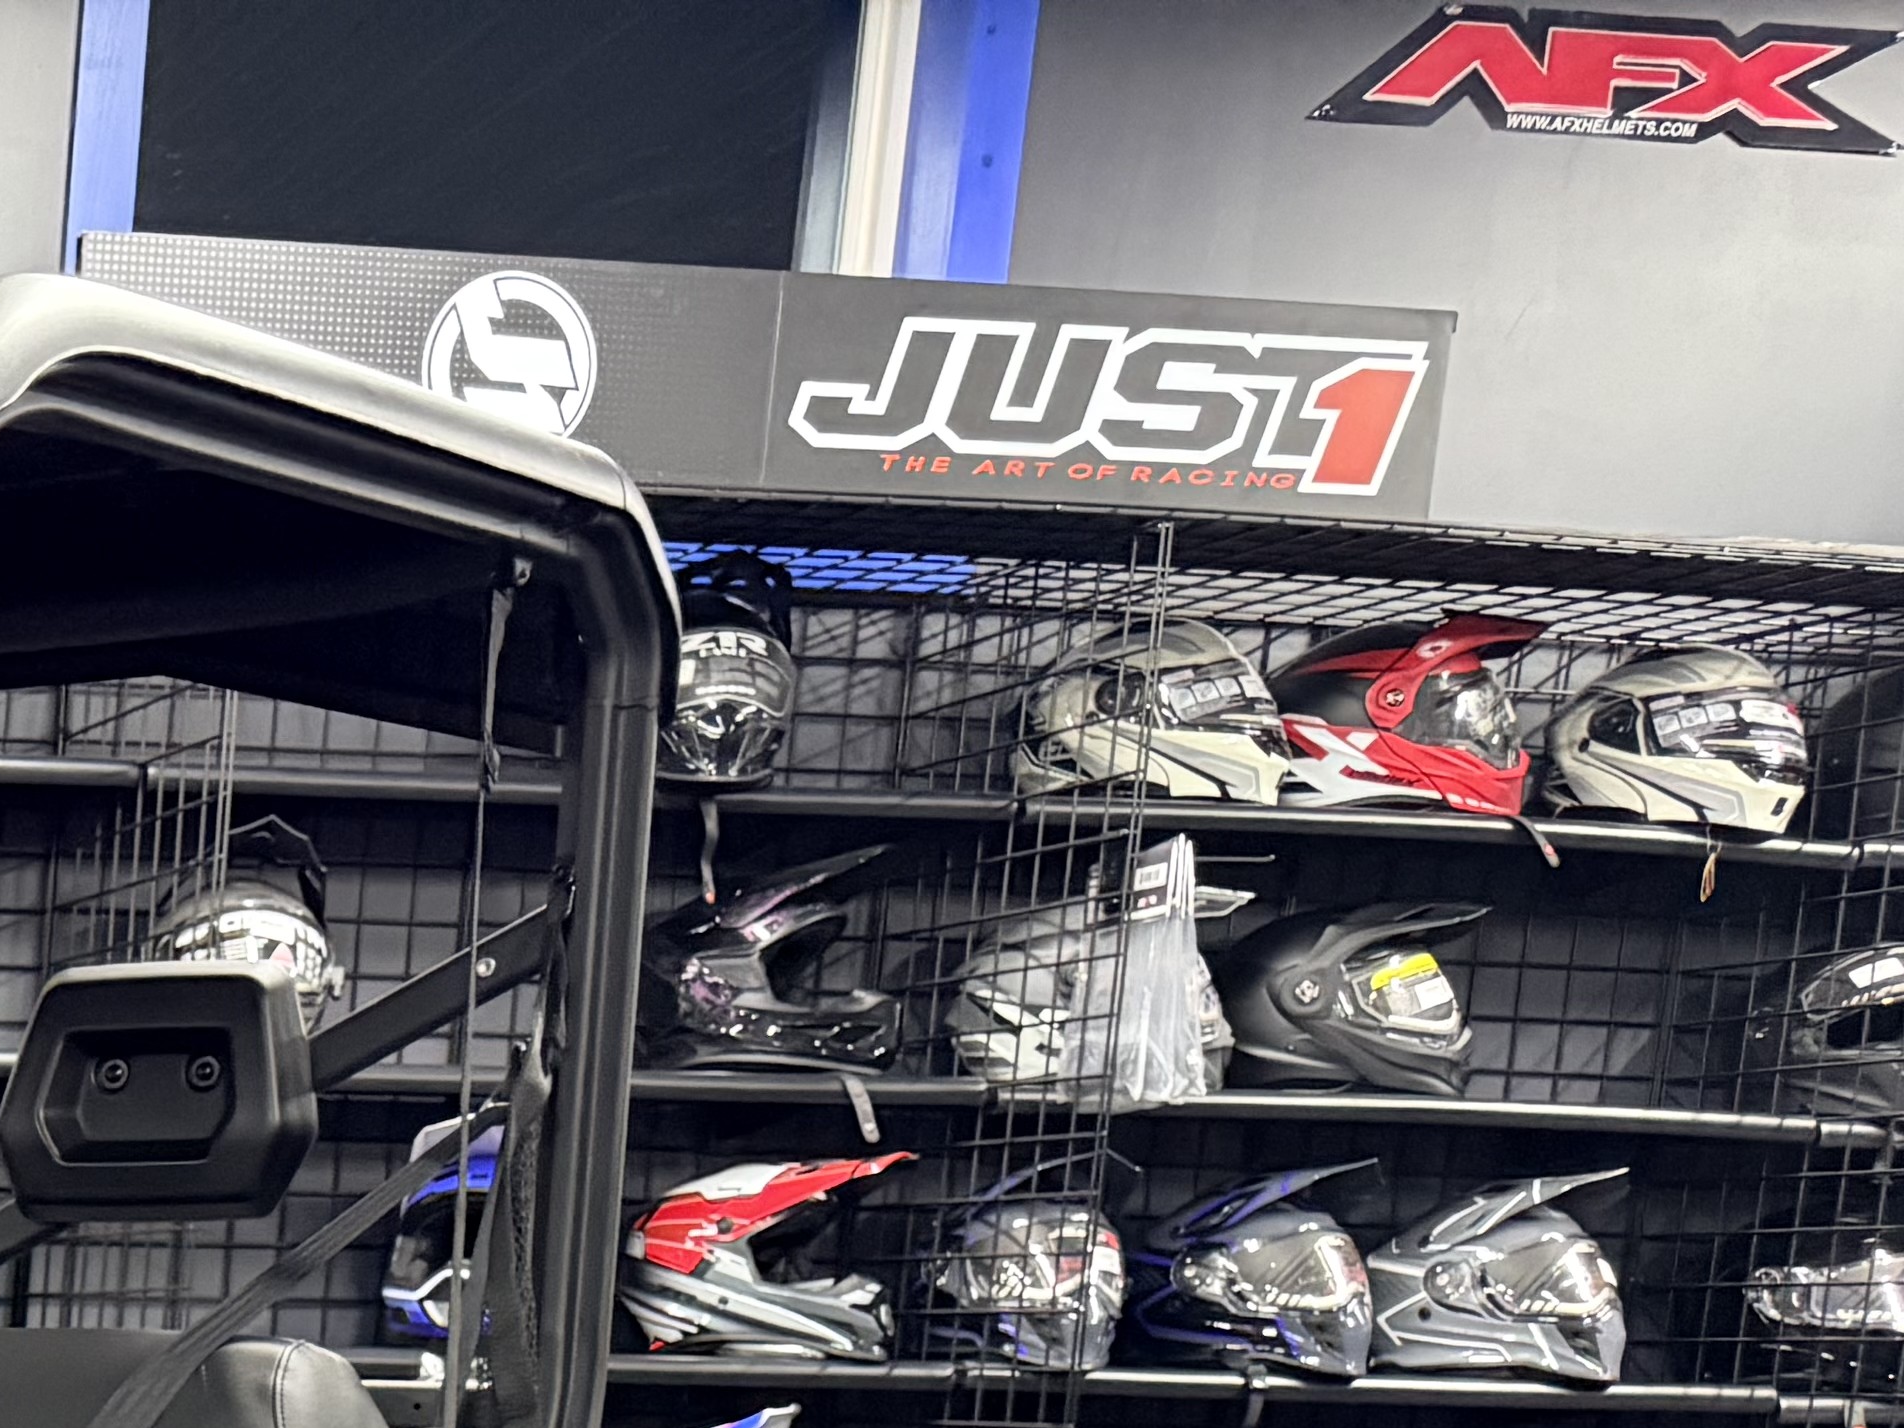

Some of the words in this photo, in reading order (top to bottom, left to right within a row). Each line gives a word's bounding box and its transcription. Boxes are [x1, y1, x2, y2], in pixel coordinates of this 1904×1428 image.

[1363, 21, 1850, 131] AFX
[1505, 113, 1698, 139] WWW.AFXHELMETS.COM
[788, 316, 1429, 496] JUST1
[879, 453, 950, 474] THE
[972, 459, 1056, 479] ART
[1067, 461, 1113, 481] OF
[1130, 466, 1297, 489] RACING
